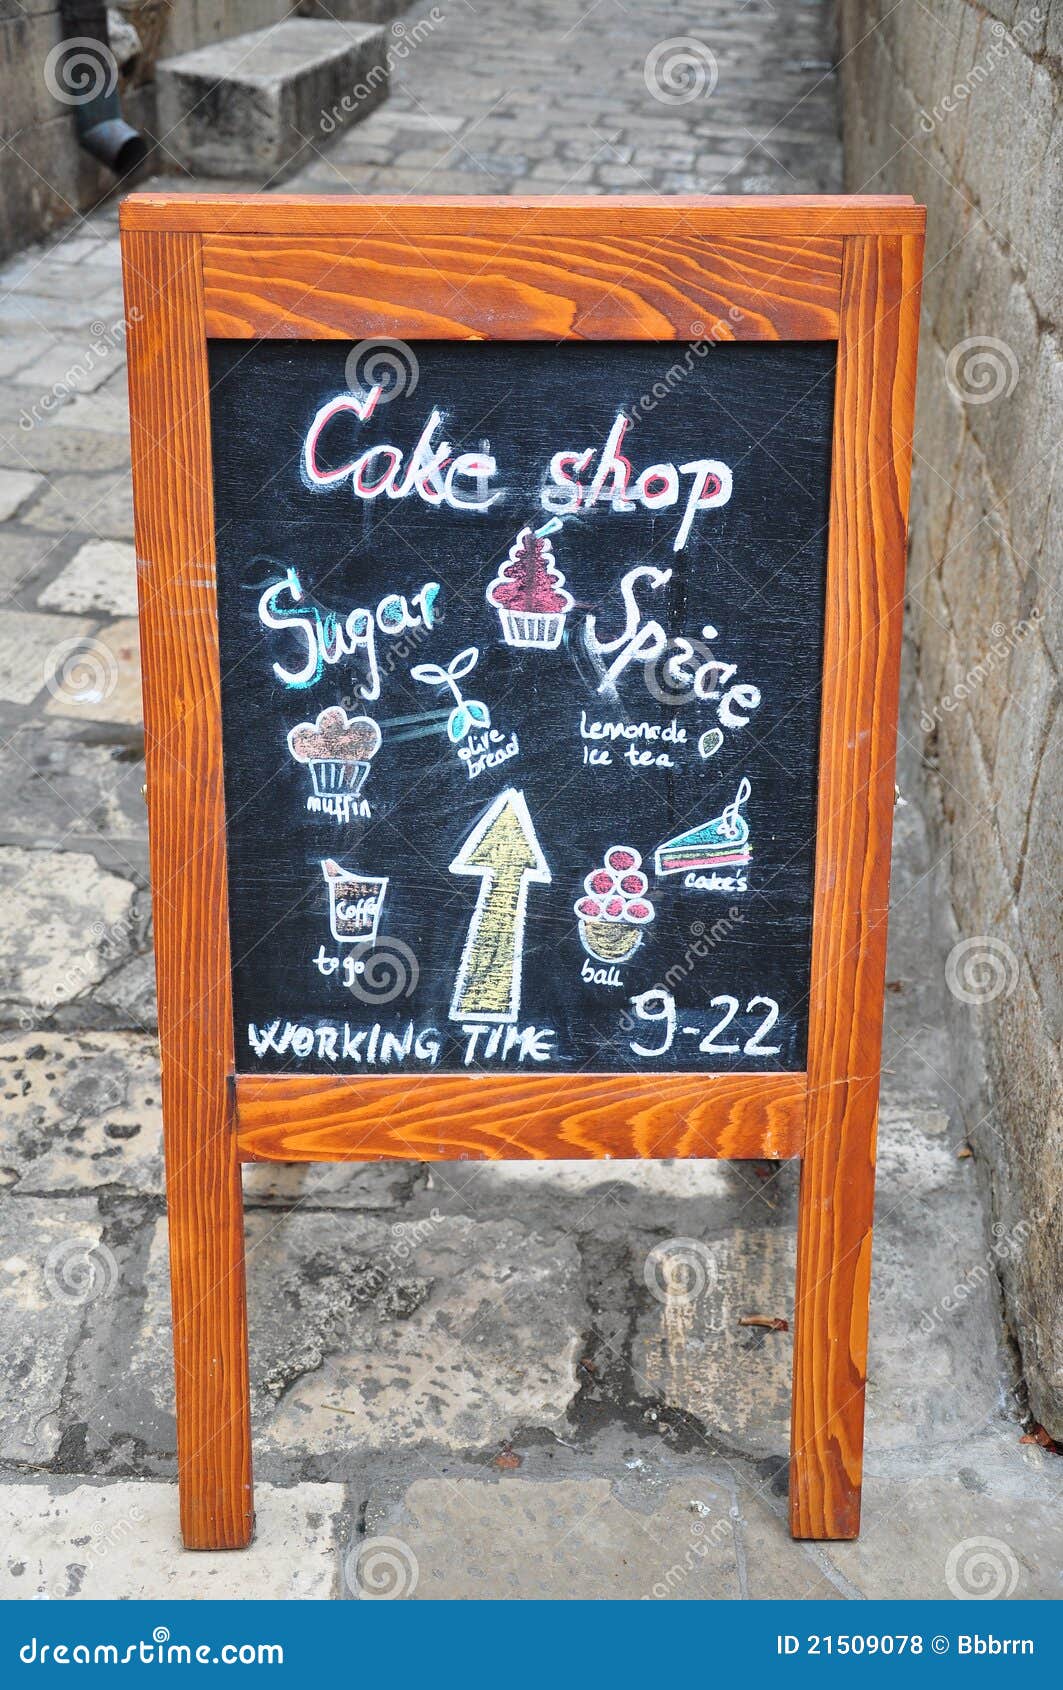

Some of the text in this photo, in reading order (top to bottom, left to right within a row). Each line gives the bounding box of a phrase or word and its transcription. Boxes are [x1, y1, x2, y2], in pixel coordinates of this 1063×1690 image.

[304, 384, 734, 552] Cake shop
[258, 567, 440, 700] Sugar
[584, 565, 762, 729] Spice
[457, 729, 506, 760] olive
[466, 732, 519, 779] bread
[624, 743, 675, 768] tea
[306, 796, 371, 823] muffin
[581, 958, 624, 986] ball
[248, 1017, 555, 1066] WORKING TIME
[629, 989, 783, 1057] 9-22
